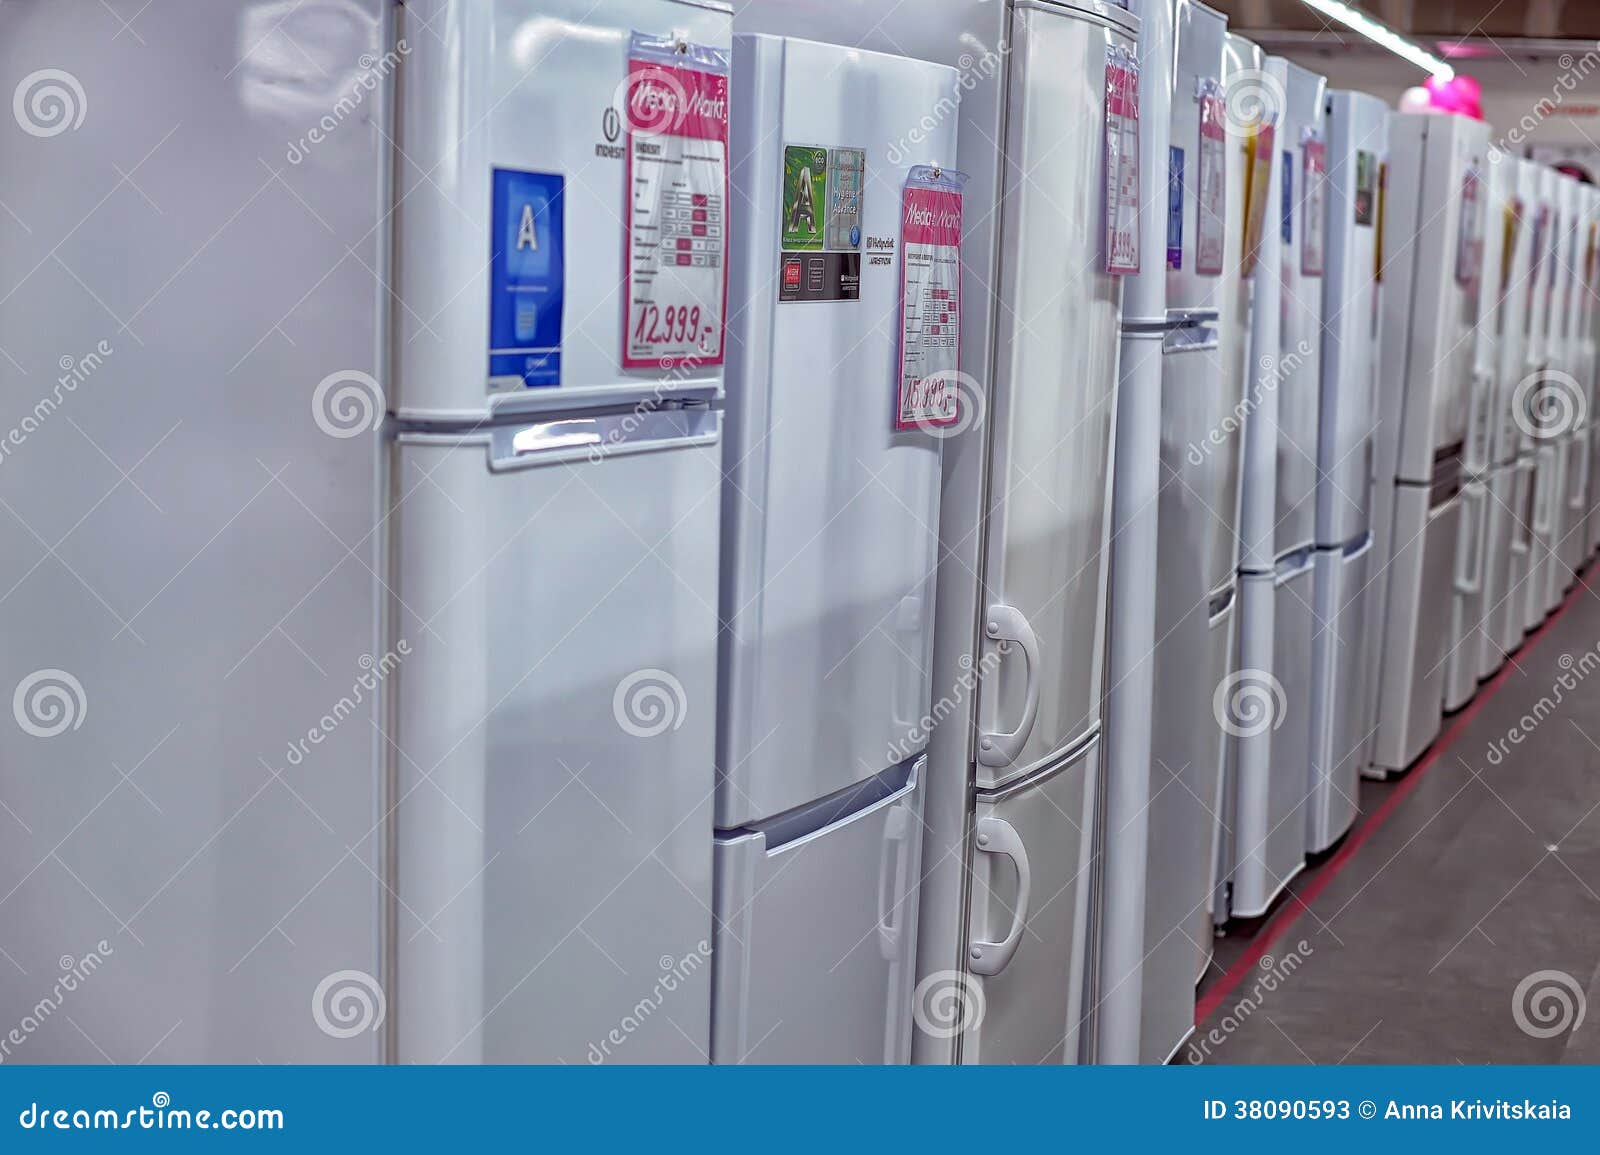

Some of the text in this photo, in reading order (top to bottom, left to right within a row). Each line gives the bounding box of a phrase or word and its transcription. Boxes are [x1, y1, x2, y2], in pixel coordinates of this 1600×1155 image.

[687, 85, 725, 119] Markt
[788, 166, 817, 234] A
[904, 202, 932, 226] Media
[516, 203, 538, 251] A
